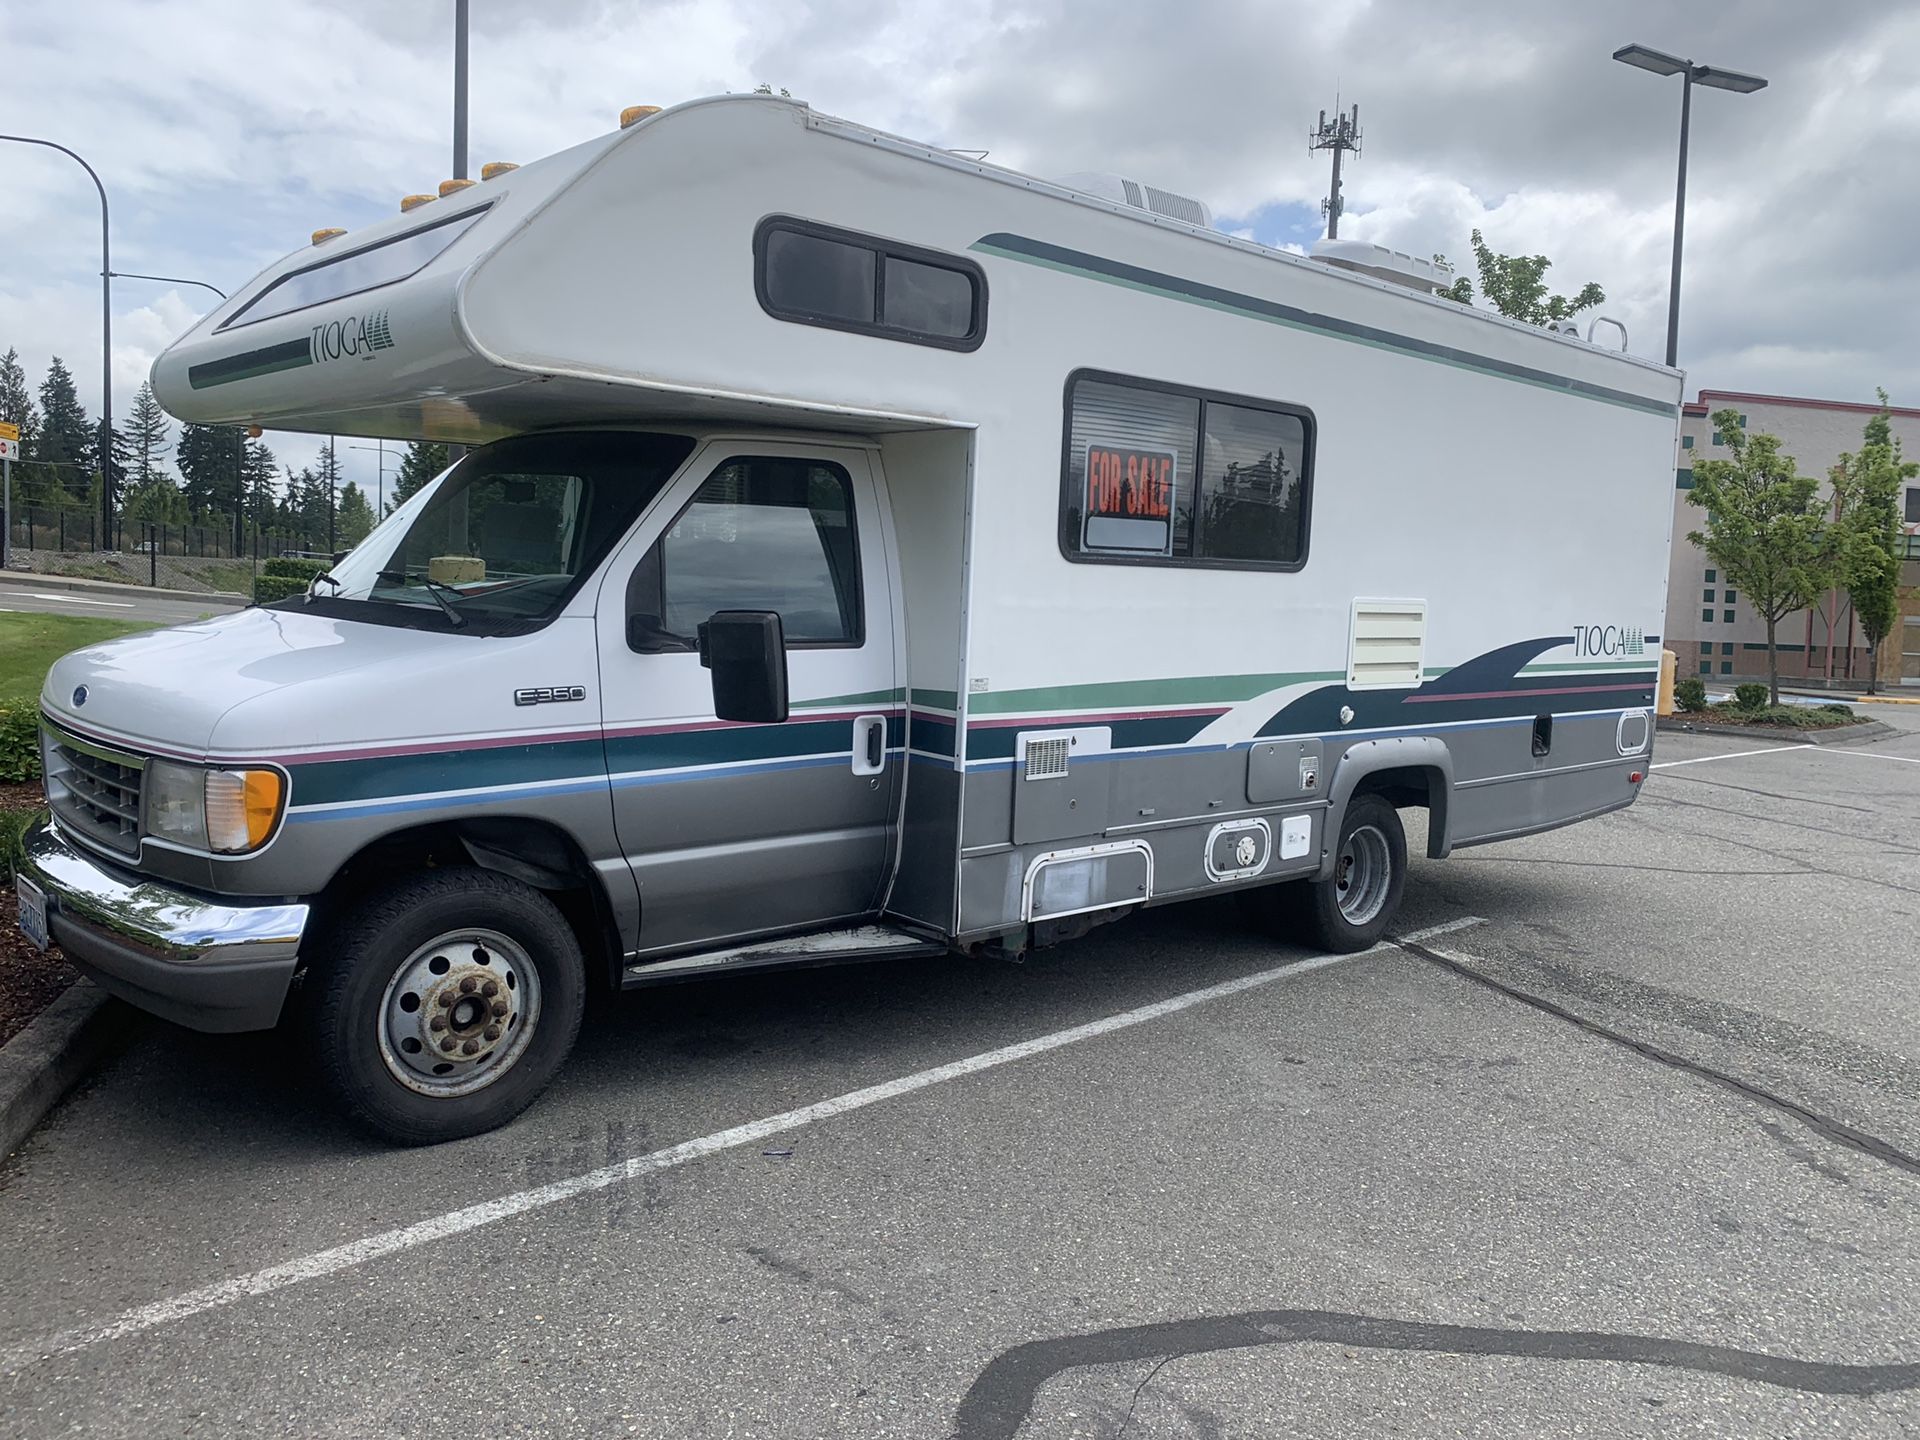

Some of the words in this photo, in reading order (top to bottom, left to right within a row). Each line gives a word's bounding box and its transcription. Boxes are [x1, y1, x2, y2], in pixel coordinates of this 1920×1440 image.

[311, 315, 373, 364] TIOGA
[1089, 451, 1121, 513] FOR
[1127, 454, 1170, 516] SALE
[1573, 625, 1626, 657] TIOGA
